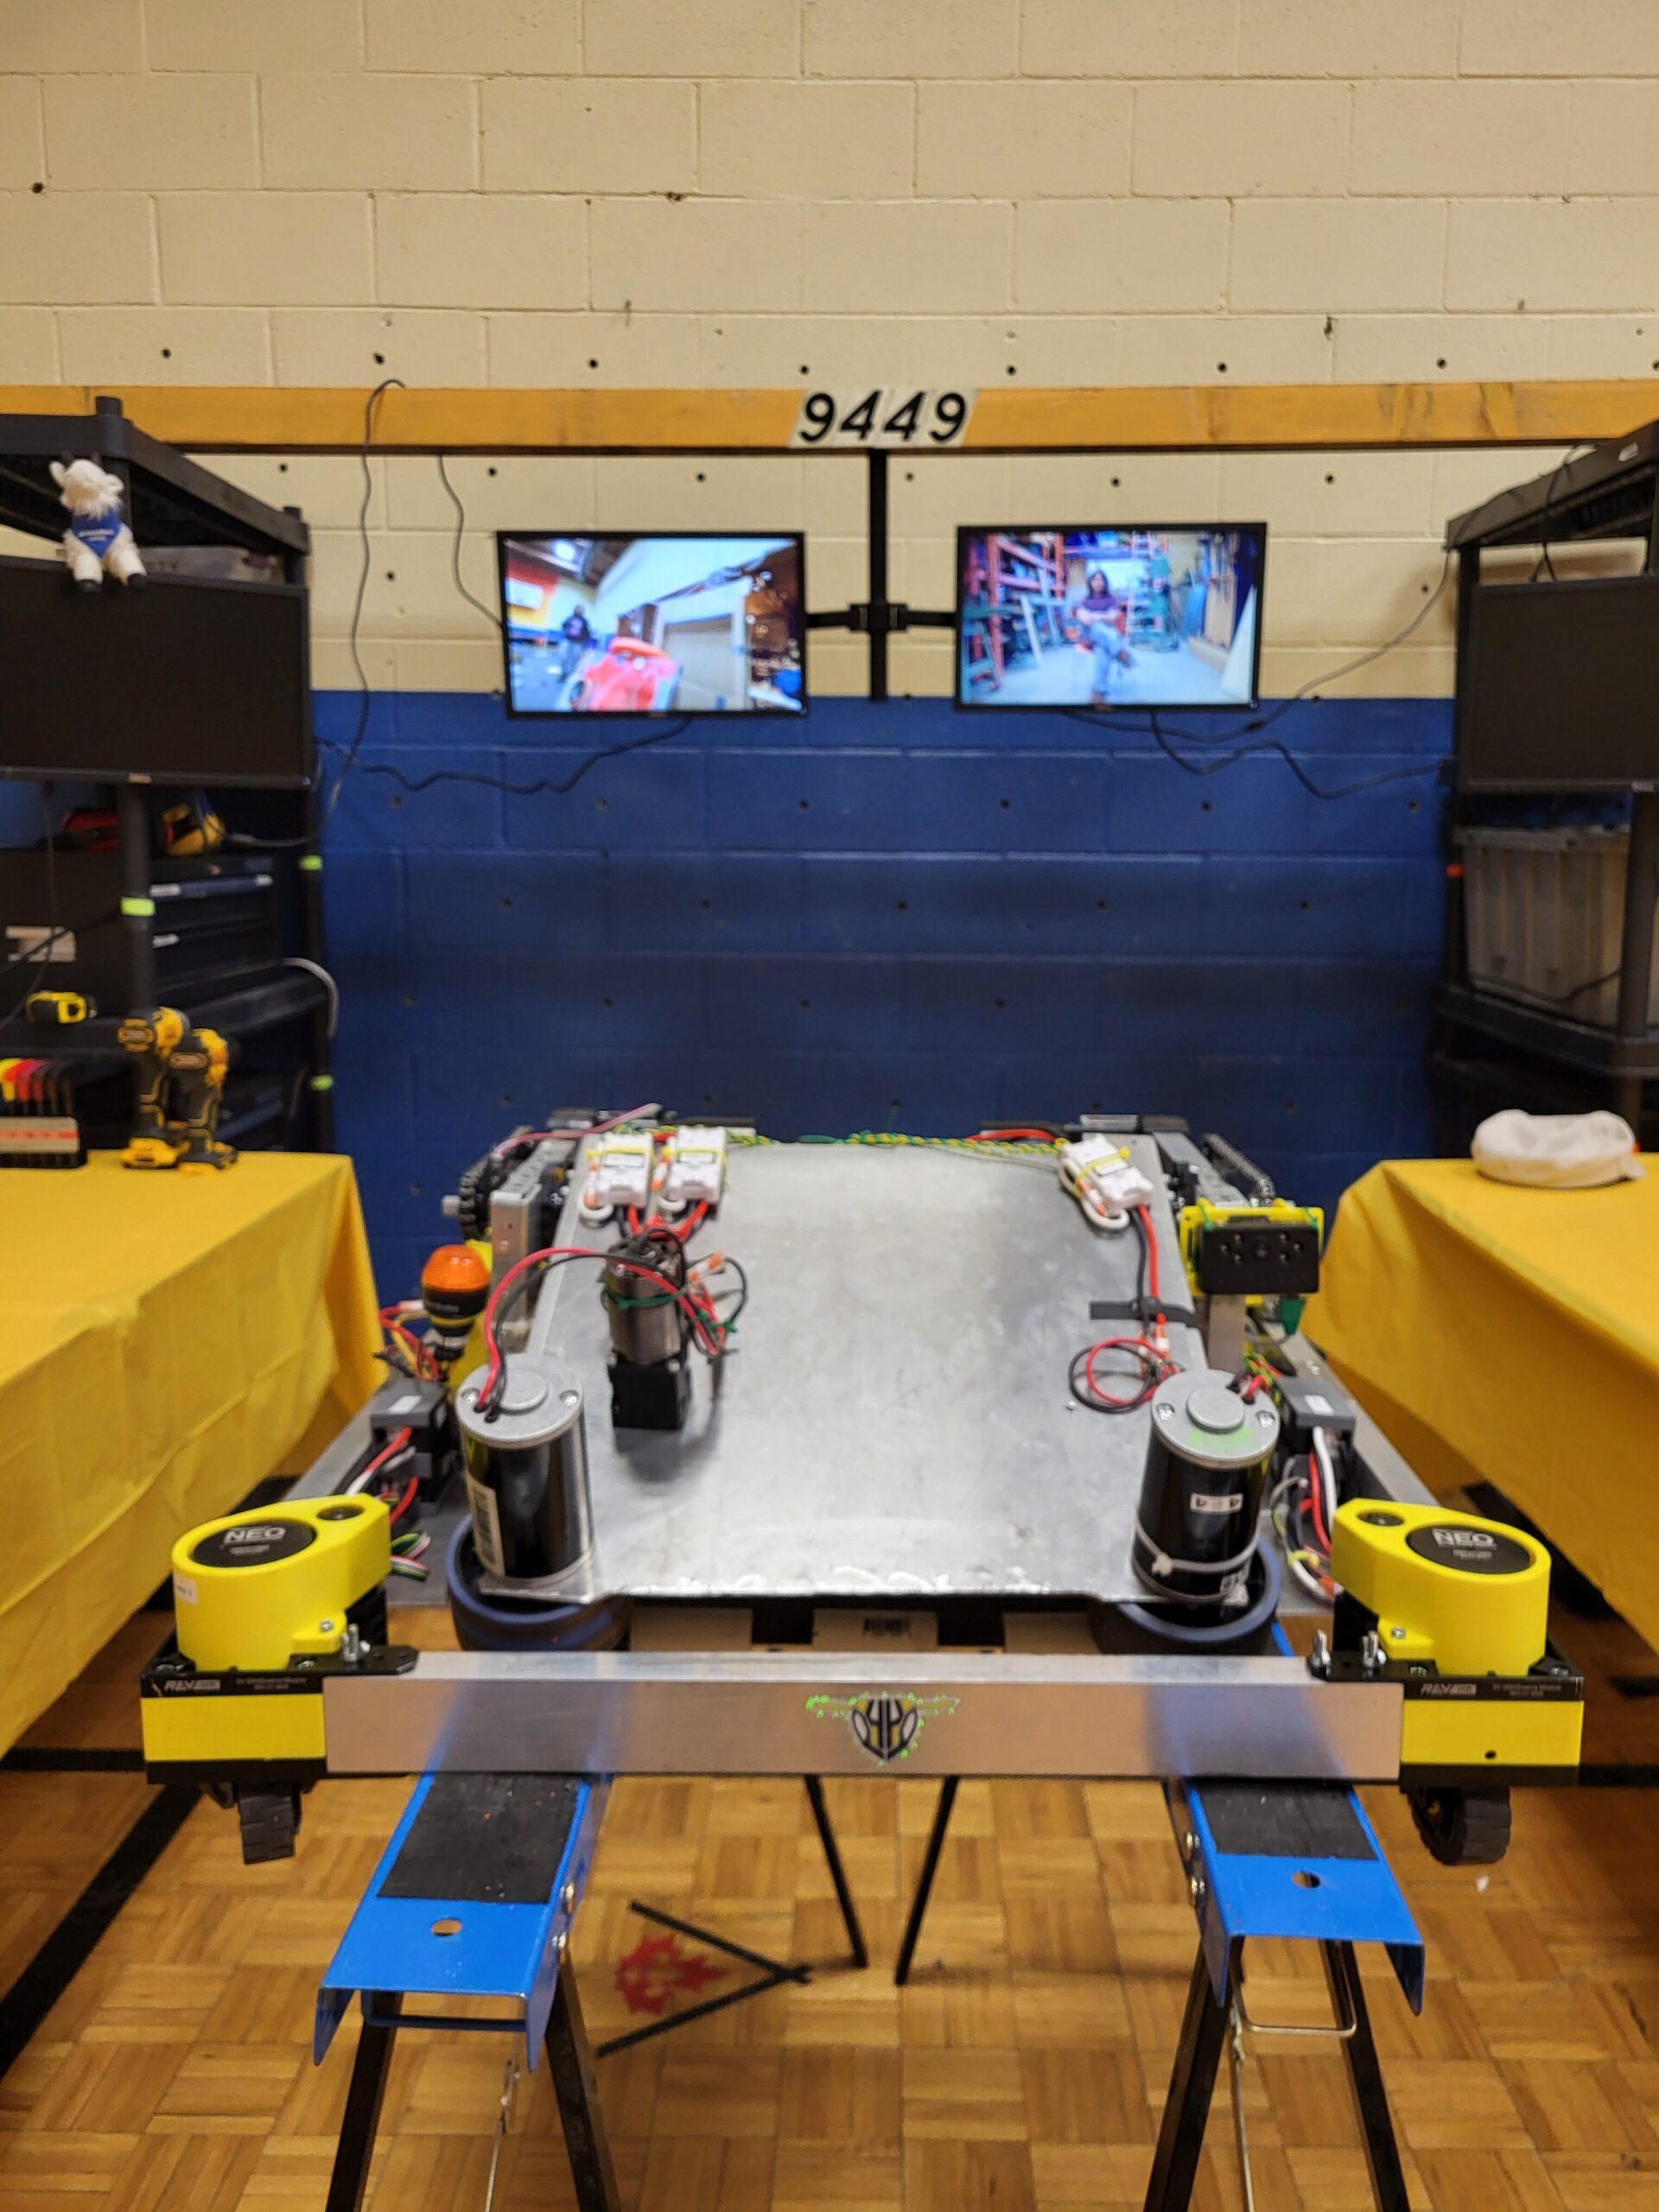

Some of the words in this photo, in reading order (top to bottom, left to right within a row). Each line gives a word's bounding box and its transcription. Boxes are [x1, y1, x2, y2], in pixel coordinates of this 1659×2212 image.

[798, 390, 966, 442] 9449
[224, 1526, 287, 1545] NEO
[1432, 1528, 1495, 1548] NEO
